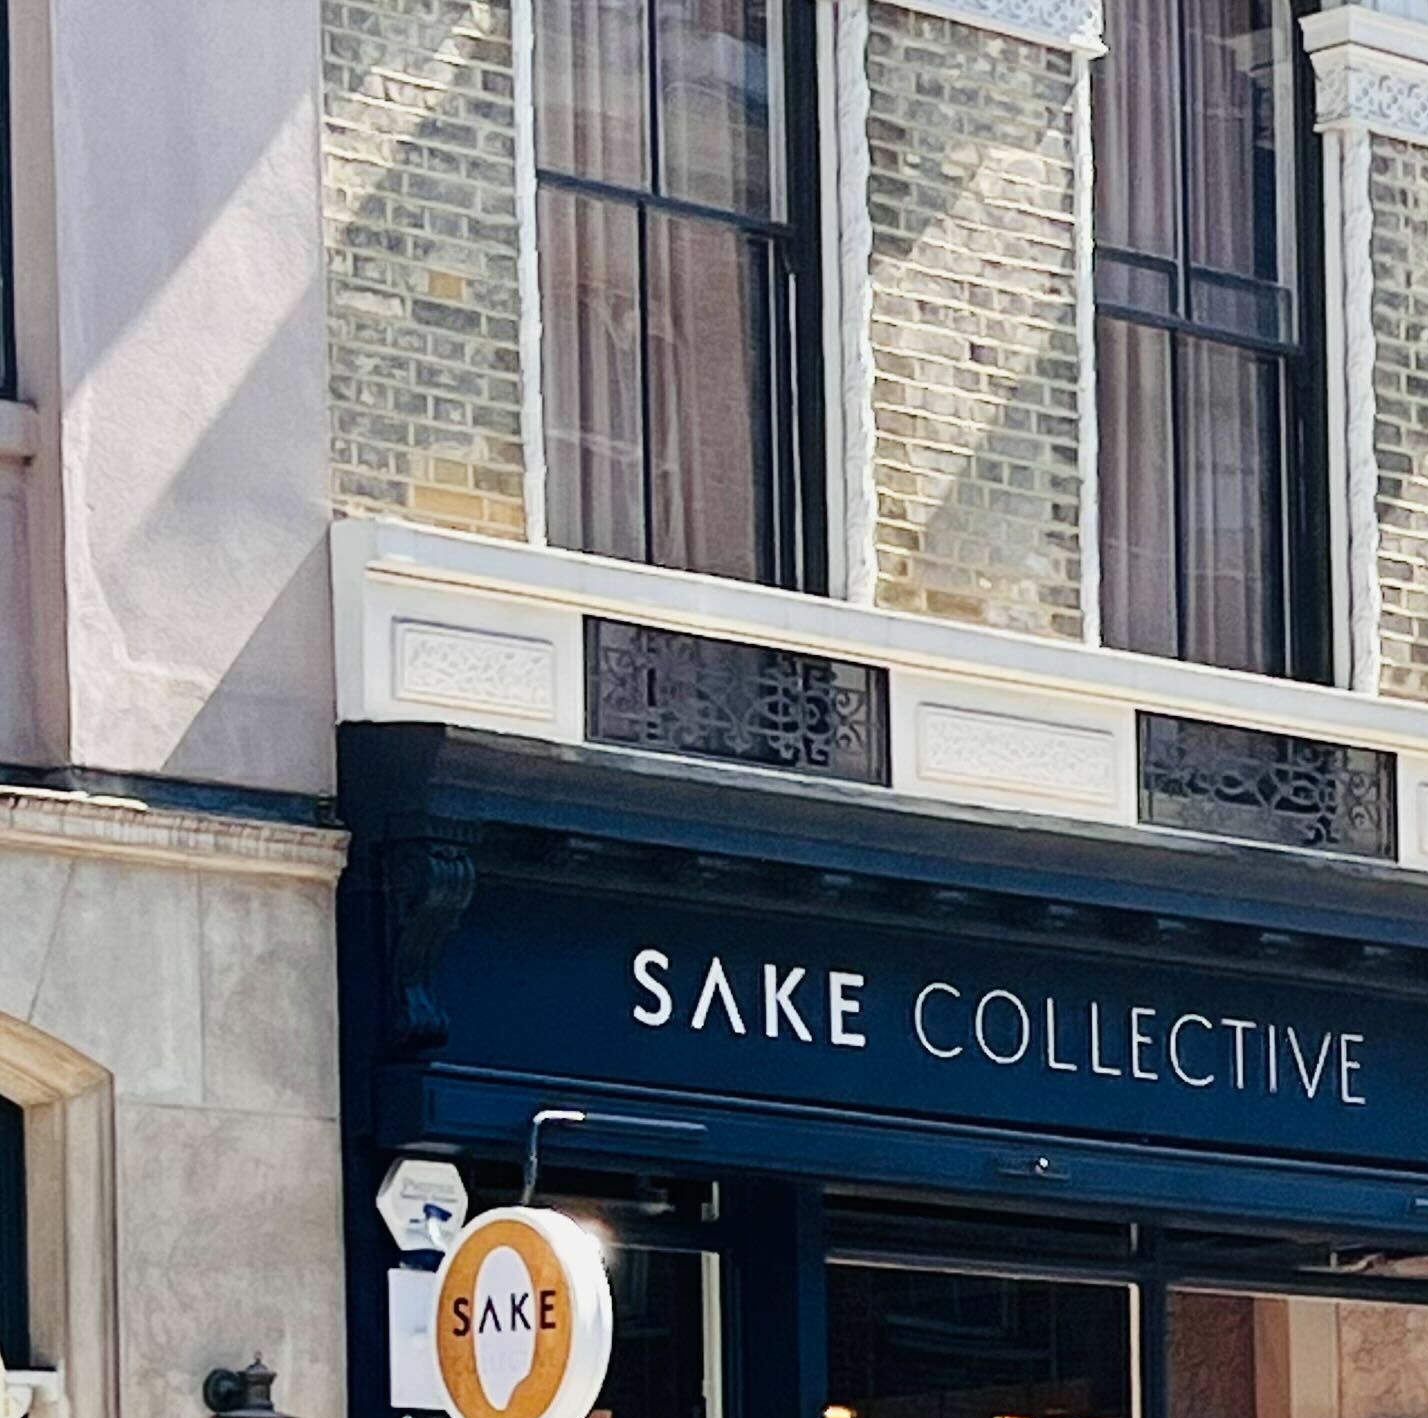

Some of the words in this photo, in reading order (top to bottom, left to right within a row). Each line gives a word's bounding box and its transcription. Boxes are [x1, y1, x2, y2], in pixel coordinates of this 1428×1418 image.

[632, 948, 866, 1048] SAKE
[914, 981, 1367, 1105] COLLECTIVE
[452, 1289, 557, 1338] SAKE
